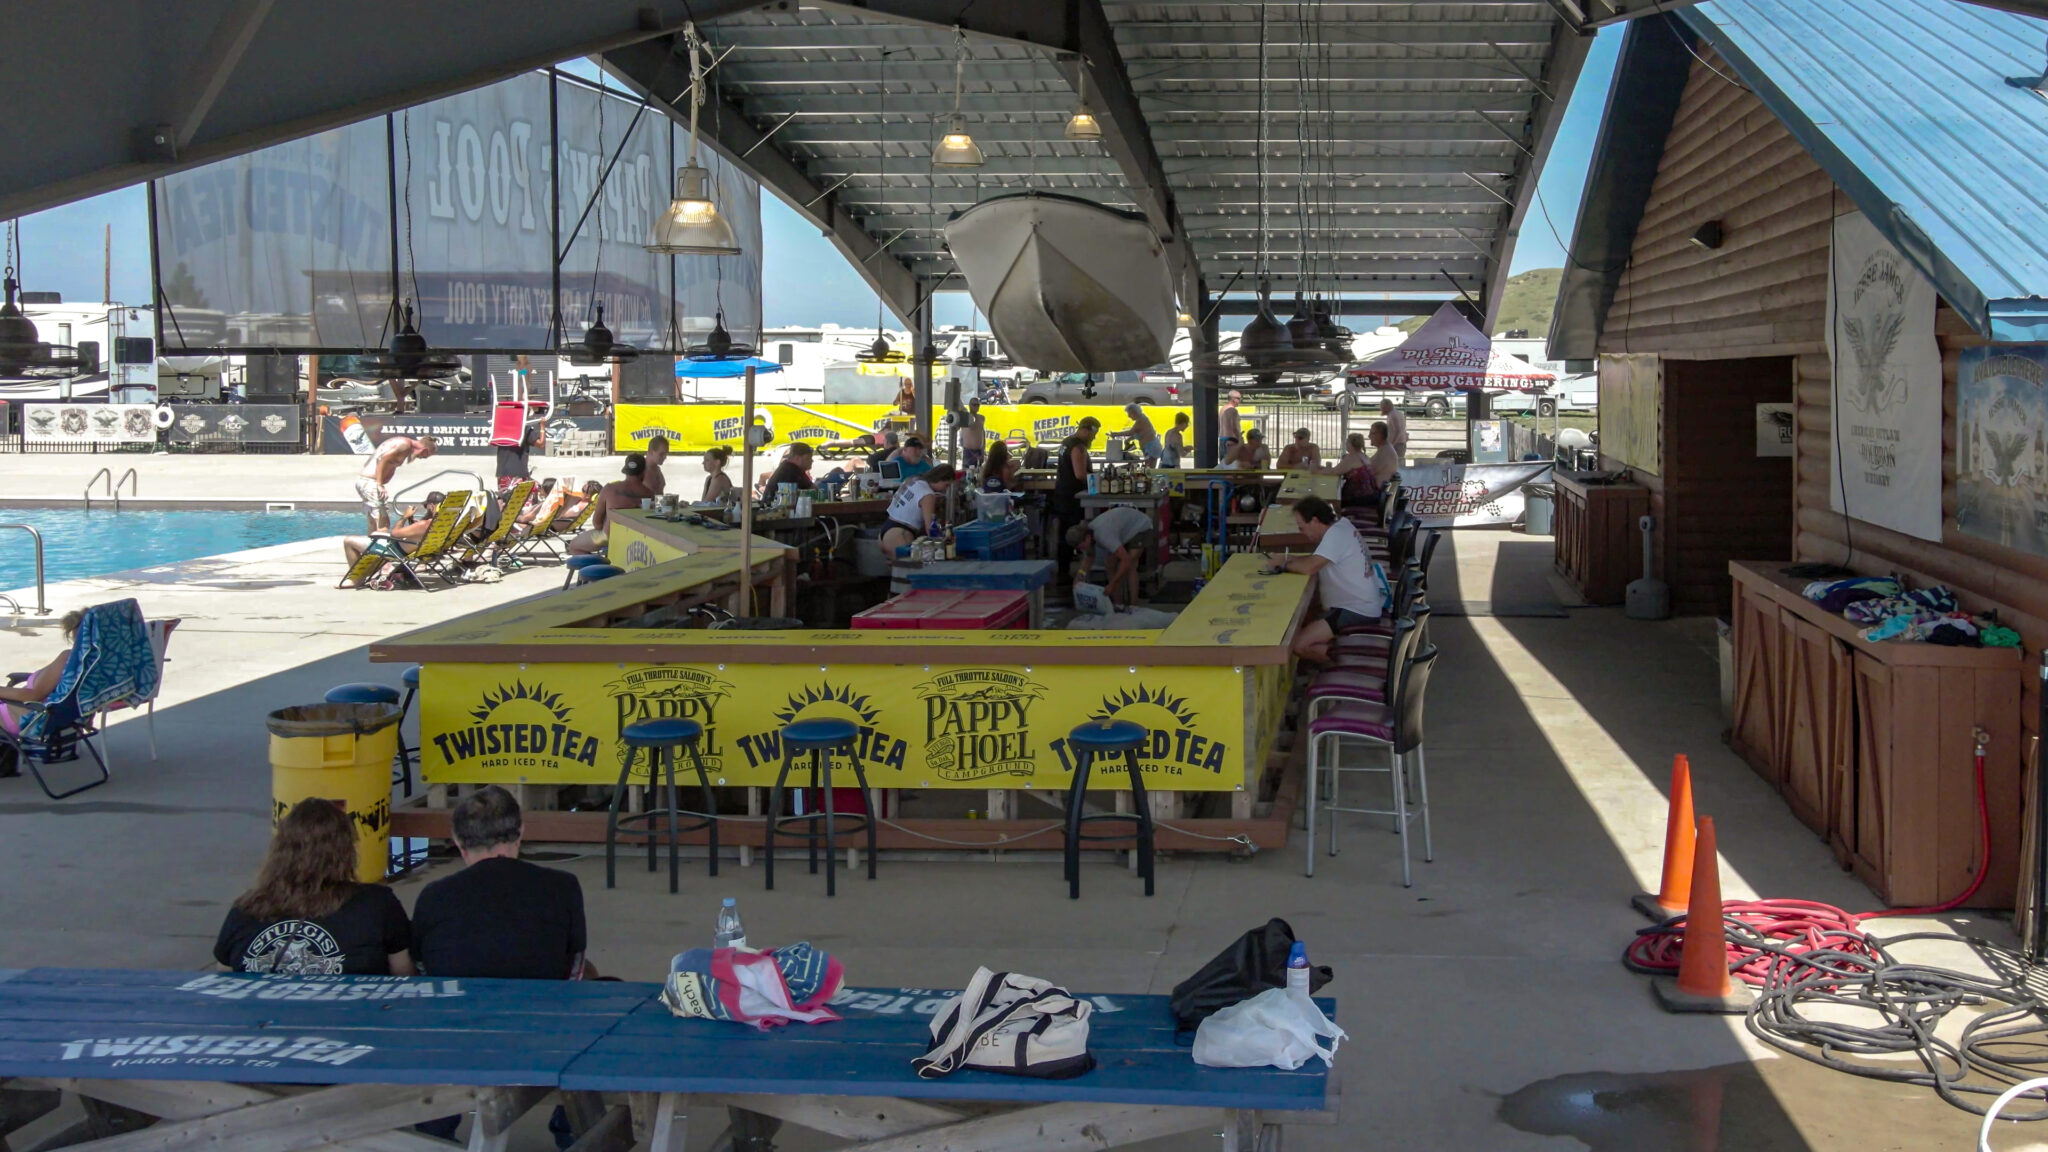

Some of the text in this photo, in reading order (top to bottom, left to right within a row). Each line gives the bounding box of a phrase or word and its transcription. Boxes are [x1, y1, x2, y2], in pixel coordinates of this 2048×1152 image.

[1430, 347, 1471, 361] Stop
[1380, 375, 1405, 386] PIT
[1412, 375, 1449, 387] STOP
[1457, 376, 1530, 389] CATERING
[381, 425, 430, 434] ALWAYS
[433, 425, 470, 435] DRINK
[714, 418, 739, 431] KEEP
[1034, 415, 1071, 432] KEEP IT
[460, 436, 489, 447] THE
[630, 428, 682, 441] TWISTED TEA
[788, 428, 840, 441] TWISTED TEA
[1428, 486, 1463, 504] Stop
[1412, 500, 1480, 516] Catering
[627, 669, 712, 685] FULL THROTTLE SALOON'S
[937, 671, 1025, 687] FULL THROTTLE SALOON'S
[924, 694, 1036, 748] PAPPY
[432, 724, 548, 766] TWISTED
[551, 723, 599, 767] TEA
[859, 726, 908, 772] TEA
[957, 730, 1036, 771] HOEL
[1175, 728, 1226, 774] TEA
[481, 757, 559, 769] HARD ICED TEA
[945, 762, 1030, 778] CAMPGROUND
[1164, 766, 1183, 776] TEA
[252, 922, 335, 953] STURGIS
[176, 974, 466, 1001] TWISTED TEA
[60, 1034, 376, 1066] TWISTED TEA
[112, 1056, 280, 1070] HARD ICED TEA
